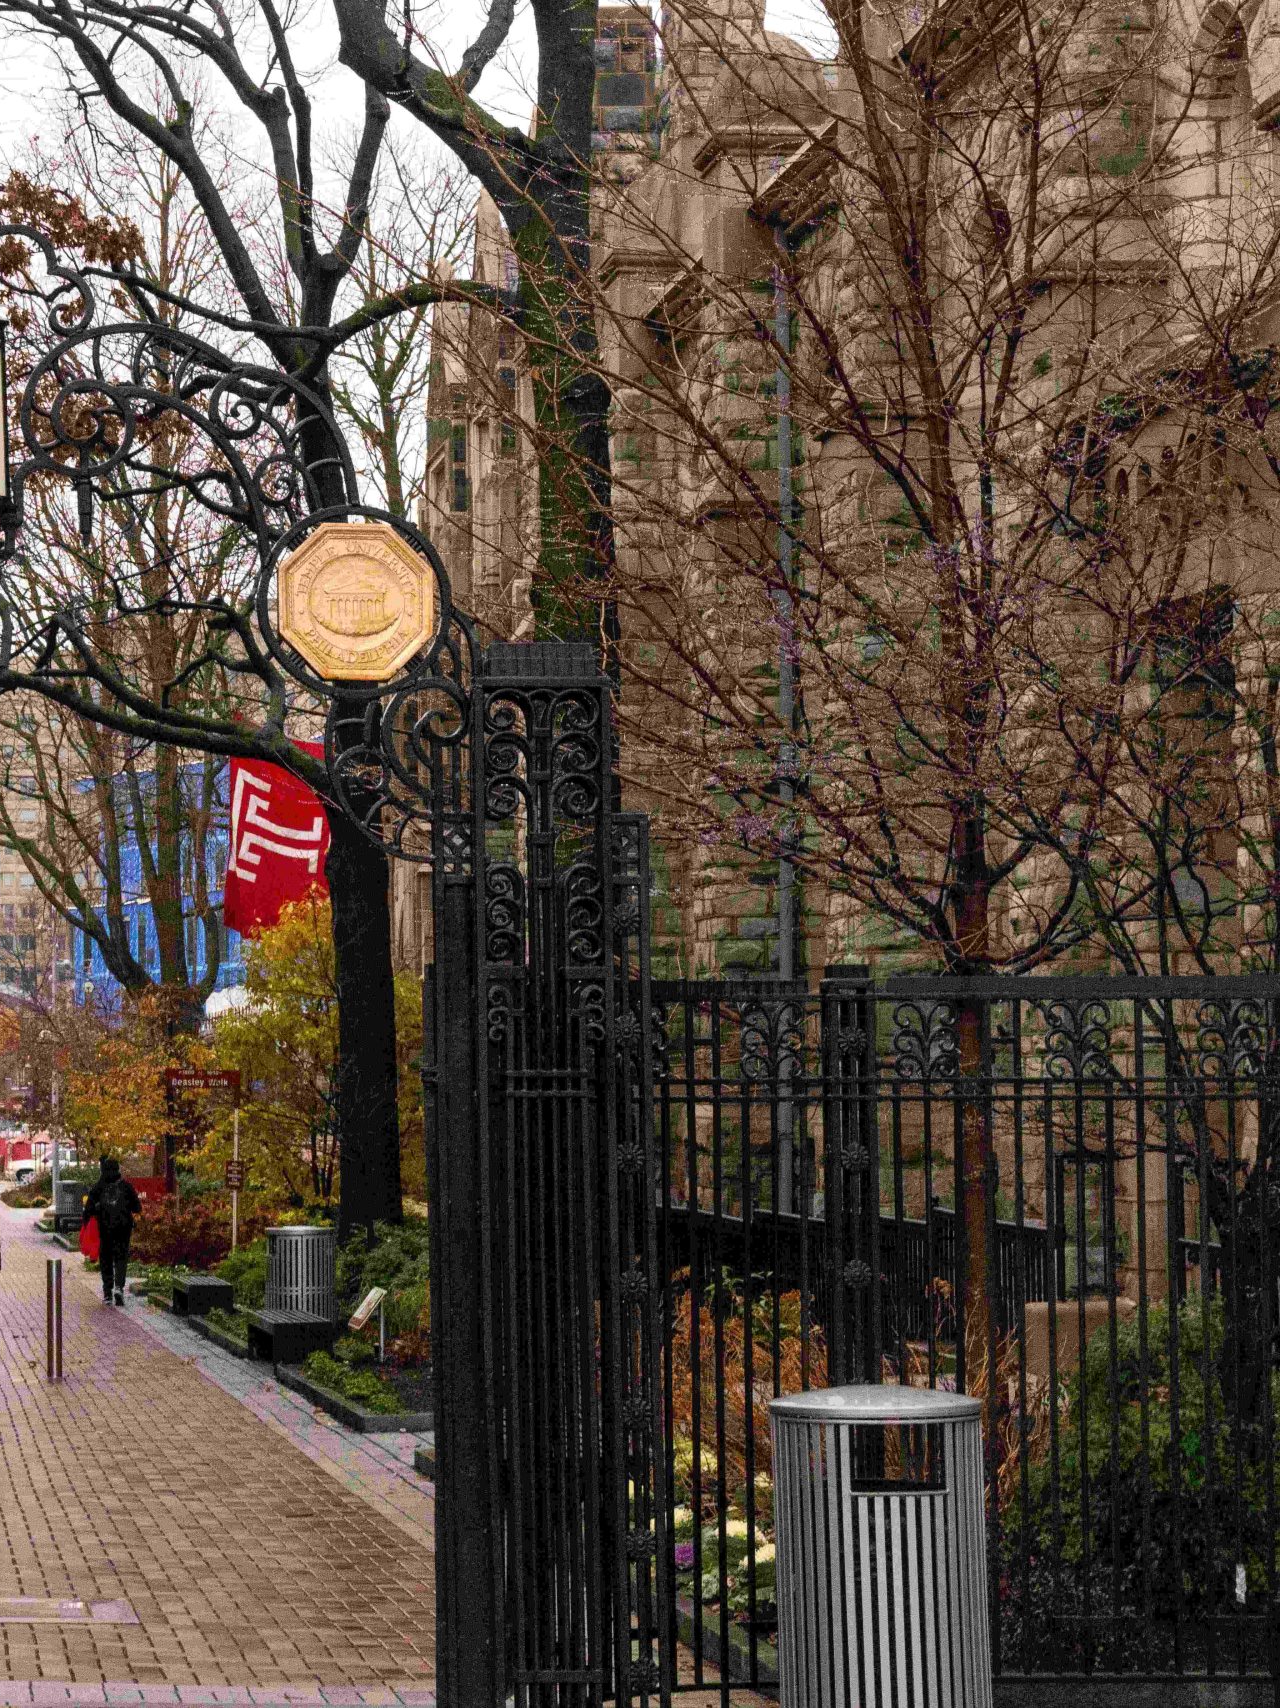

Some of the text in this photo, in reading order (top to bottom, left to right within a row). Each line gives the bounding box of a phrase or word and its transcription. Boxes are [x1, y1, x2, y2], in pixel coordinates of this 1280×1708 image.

[296, 540, 417, 600] TEMPLE UNIVERSITY
[306, 628, 407, 663] PHILADELPHIA
[171, 1078, 205, 1088] Beasley
